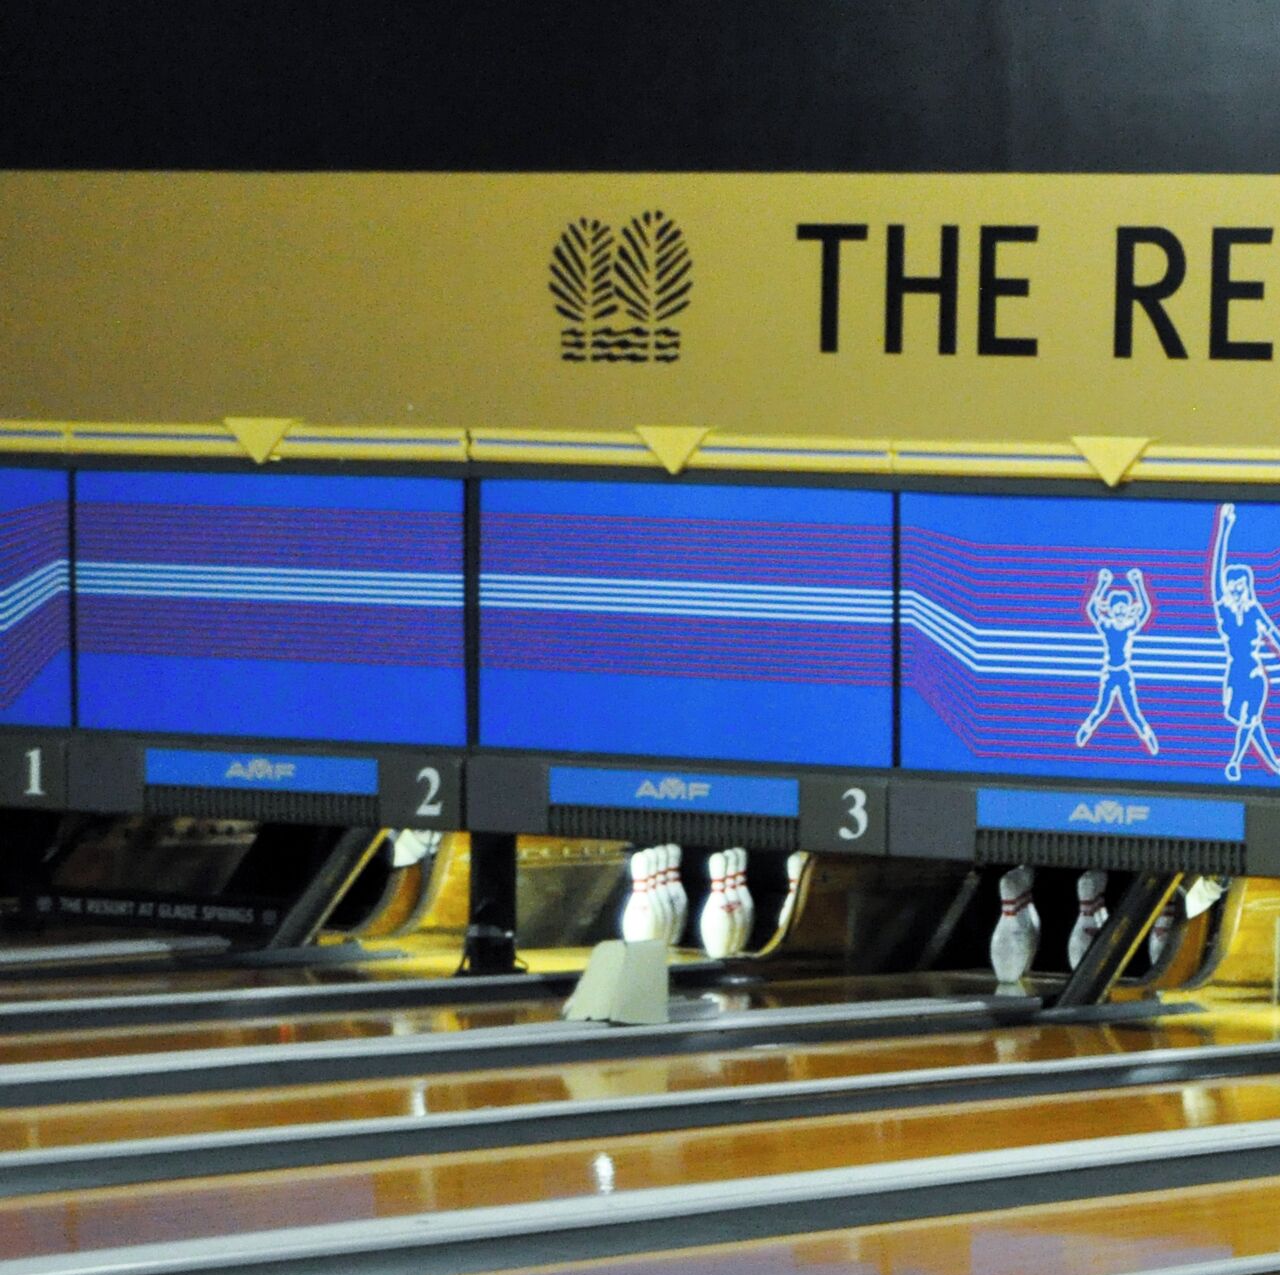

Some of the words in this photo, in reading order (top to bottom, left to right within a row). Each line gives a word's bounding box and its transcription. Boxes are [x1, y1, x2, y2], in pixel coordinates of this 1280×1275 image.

[796, 223, 1039, 357] THE
[23, 747, 46, 795] 1
[415, 767, 443, 816] 2
[635, 777, 711, 801] AMF
[838, 787, 868, 840] 3
[1068, 799, 1150, 824] AMF
